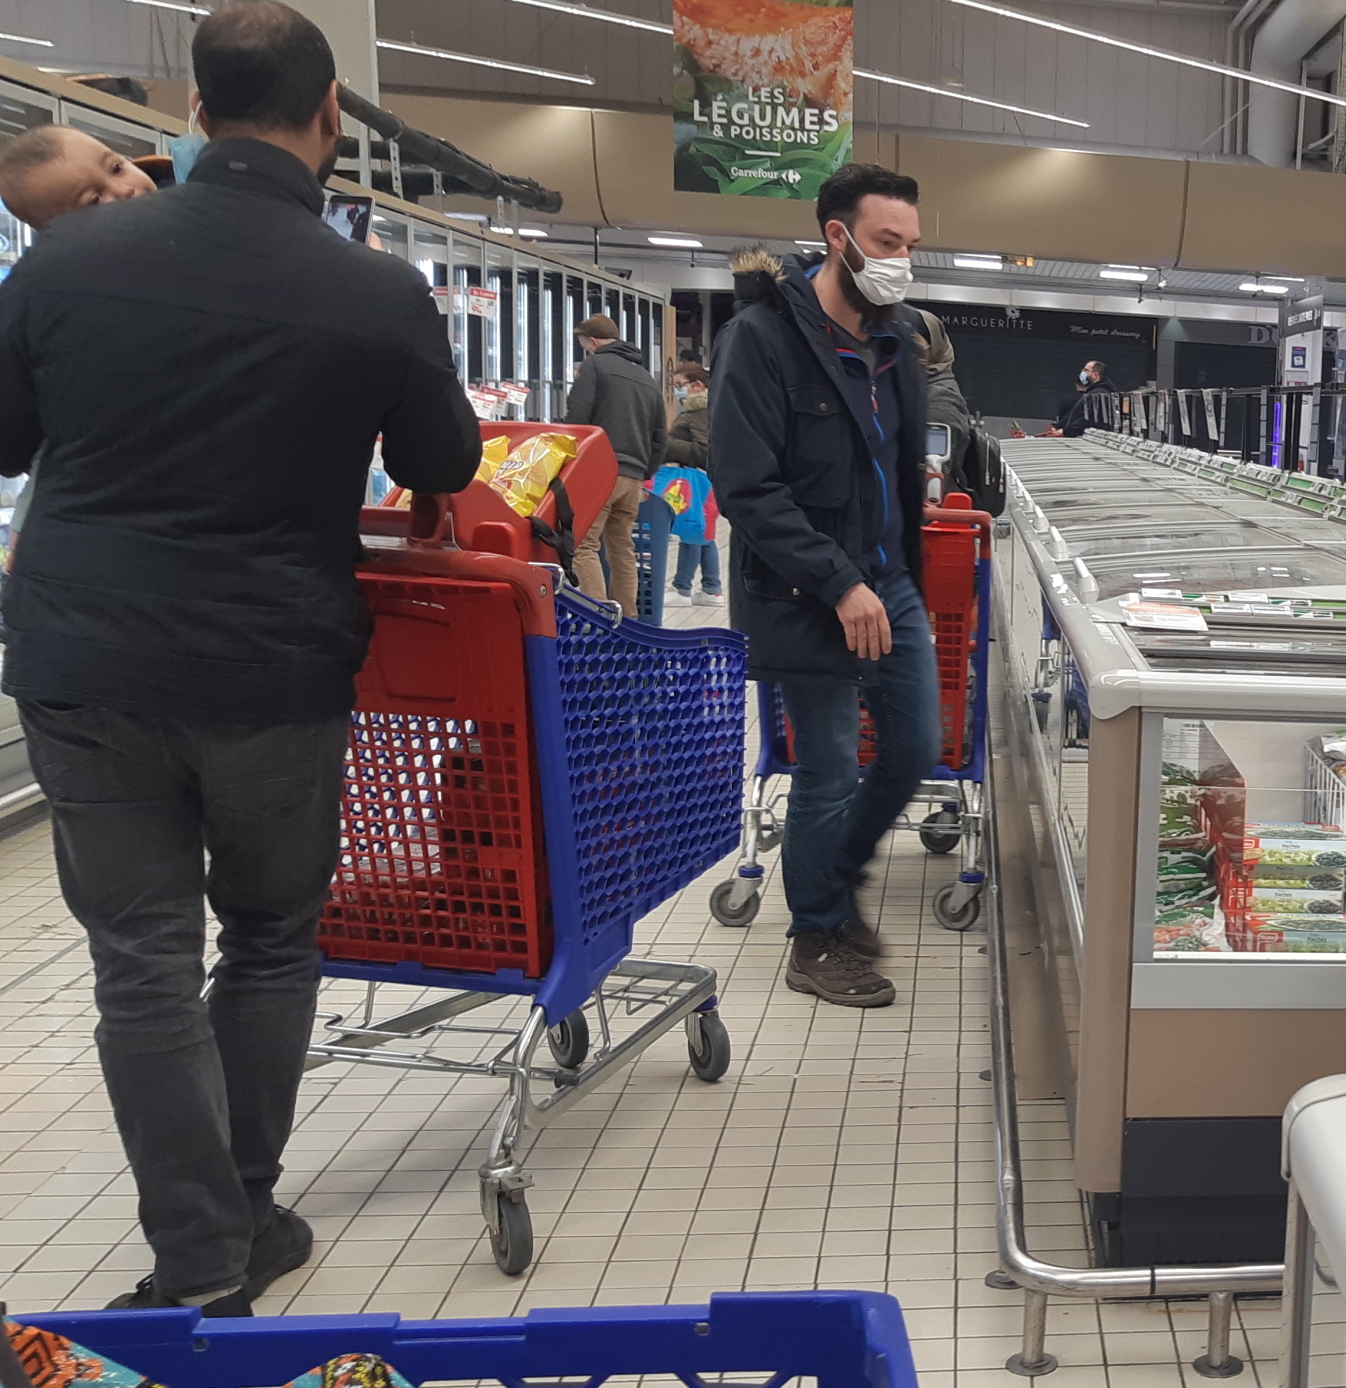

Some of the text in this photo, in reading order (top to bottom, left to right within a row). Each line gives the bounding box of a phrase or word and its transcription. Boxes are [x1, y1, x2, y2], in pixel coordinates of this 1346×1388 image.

[748, 86, 785, 104] LES
[693, 92, 839, 132] LÉGUMES
[712, 124, 819, 145] & POISSONS
[730, 166, 779, 180] Carrefour
[941, 314, 1034, 331] MARGUERITTE
